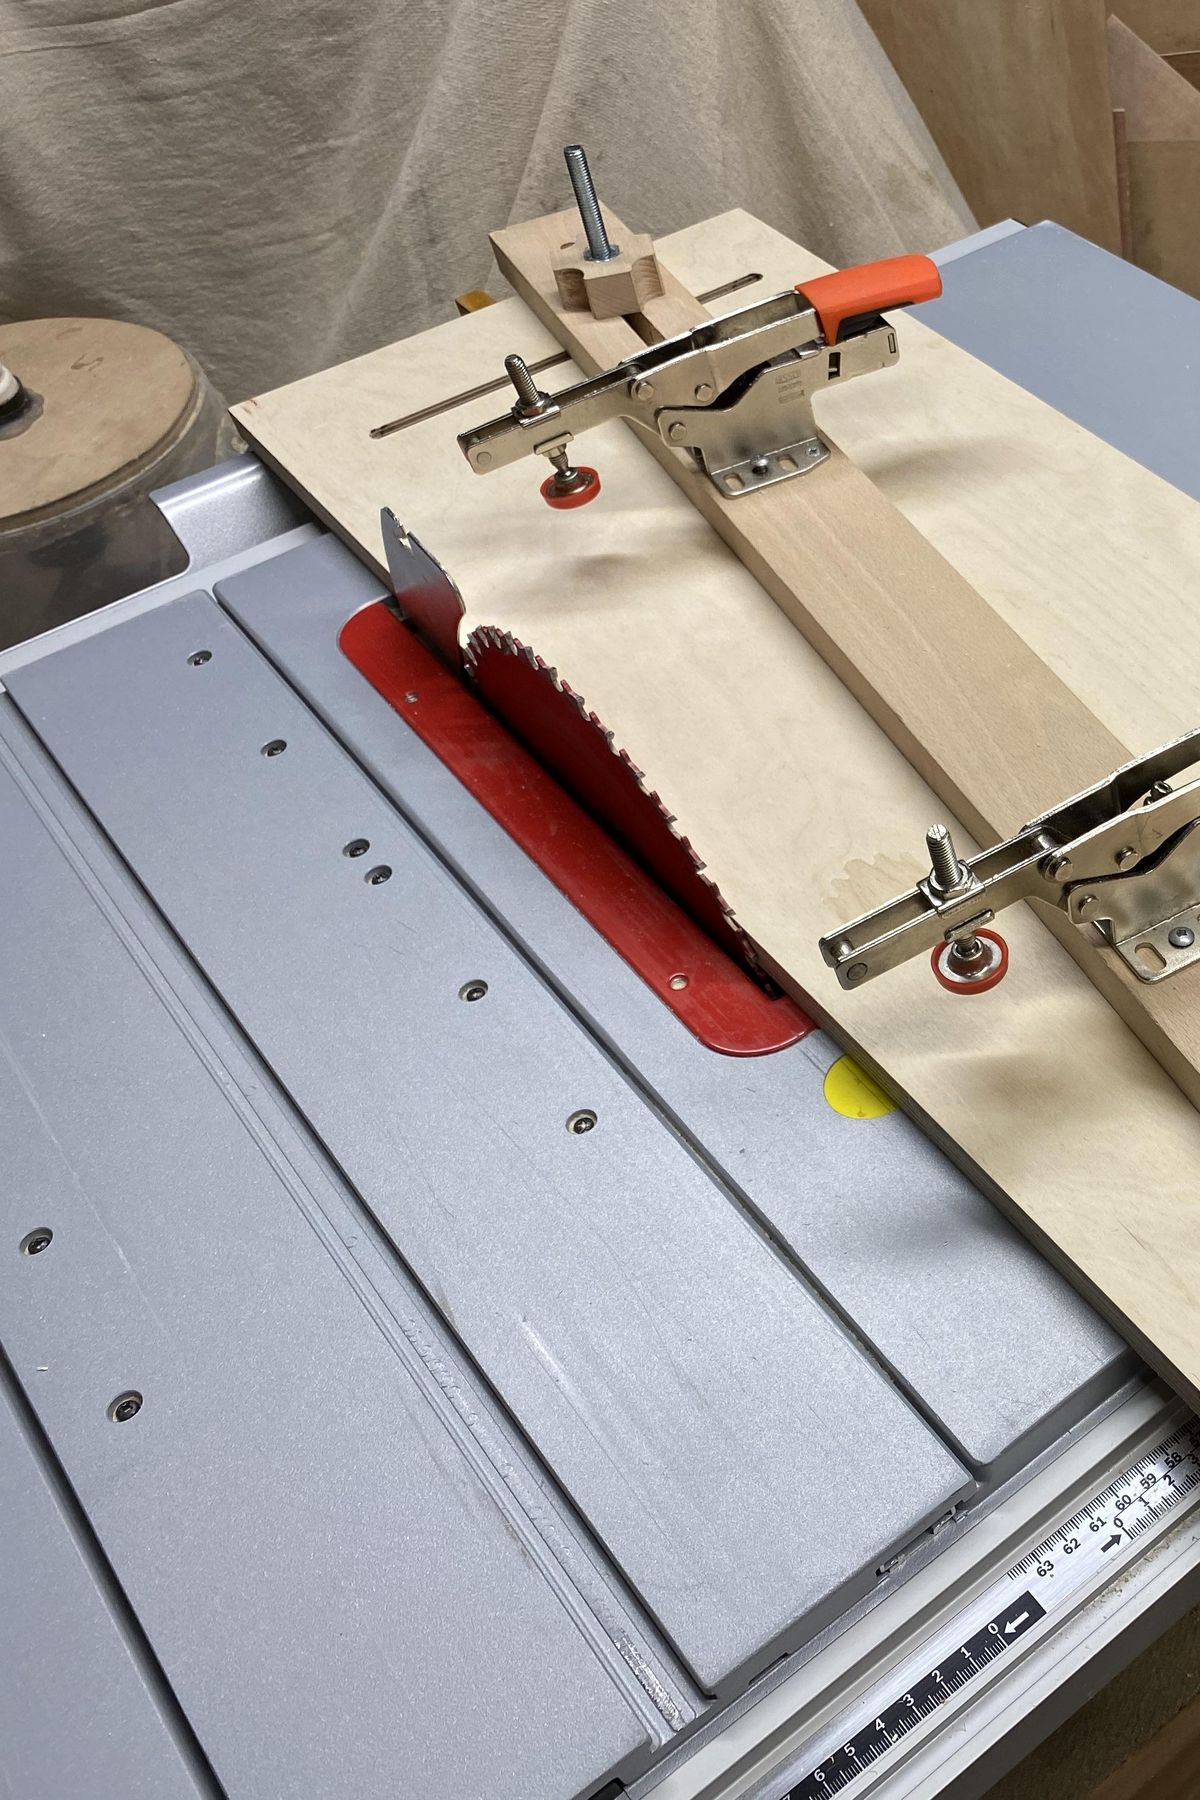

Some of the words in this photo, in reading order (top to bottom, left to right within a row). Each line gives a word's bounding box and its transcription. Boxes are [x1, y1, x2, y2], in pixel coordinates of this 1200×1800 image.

[1036, 1560, 1054, 1577] 63
[1063, 1538, 1081, 1555] 62
[1089, 1516, 1107, 1532] 61
[1115, 1494, 1132, 1511] 60
[1139, 1473, 1157, 1489] 59
[1164, 1451, 1182, 1468] 58
[1113, 1517, 1123, 1528] 0
[1138, 1496, 1149, 1507] 1
[1163, 1474, 1175, 1486] 2
[1190, 1453, 1199, 1464] 3
[814, 1768, 825, 1781] 6
[843, 1742, 855, 1757] 5
[875, 1718, 885, 1731] 4
[902, 1693, 914, 1706] 3
[931, 1669, 943, 1683] 2
[960, 1646, 971, 1659] 1
[987, 1622, 998, 1634] 0
